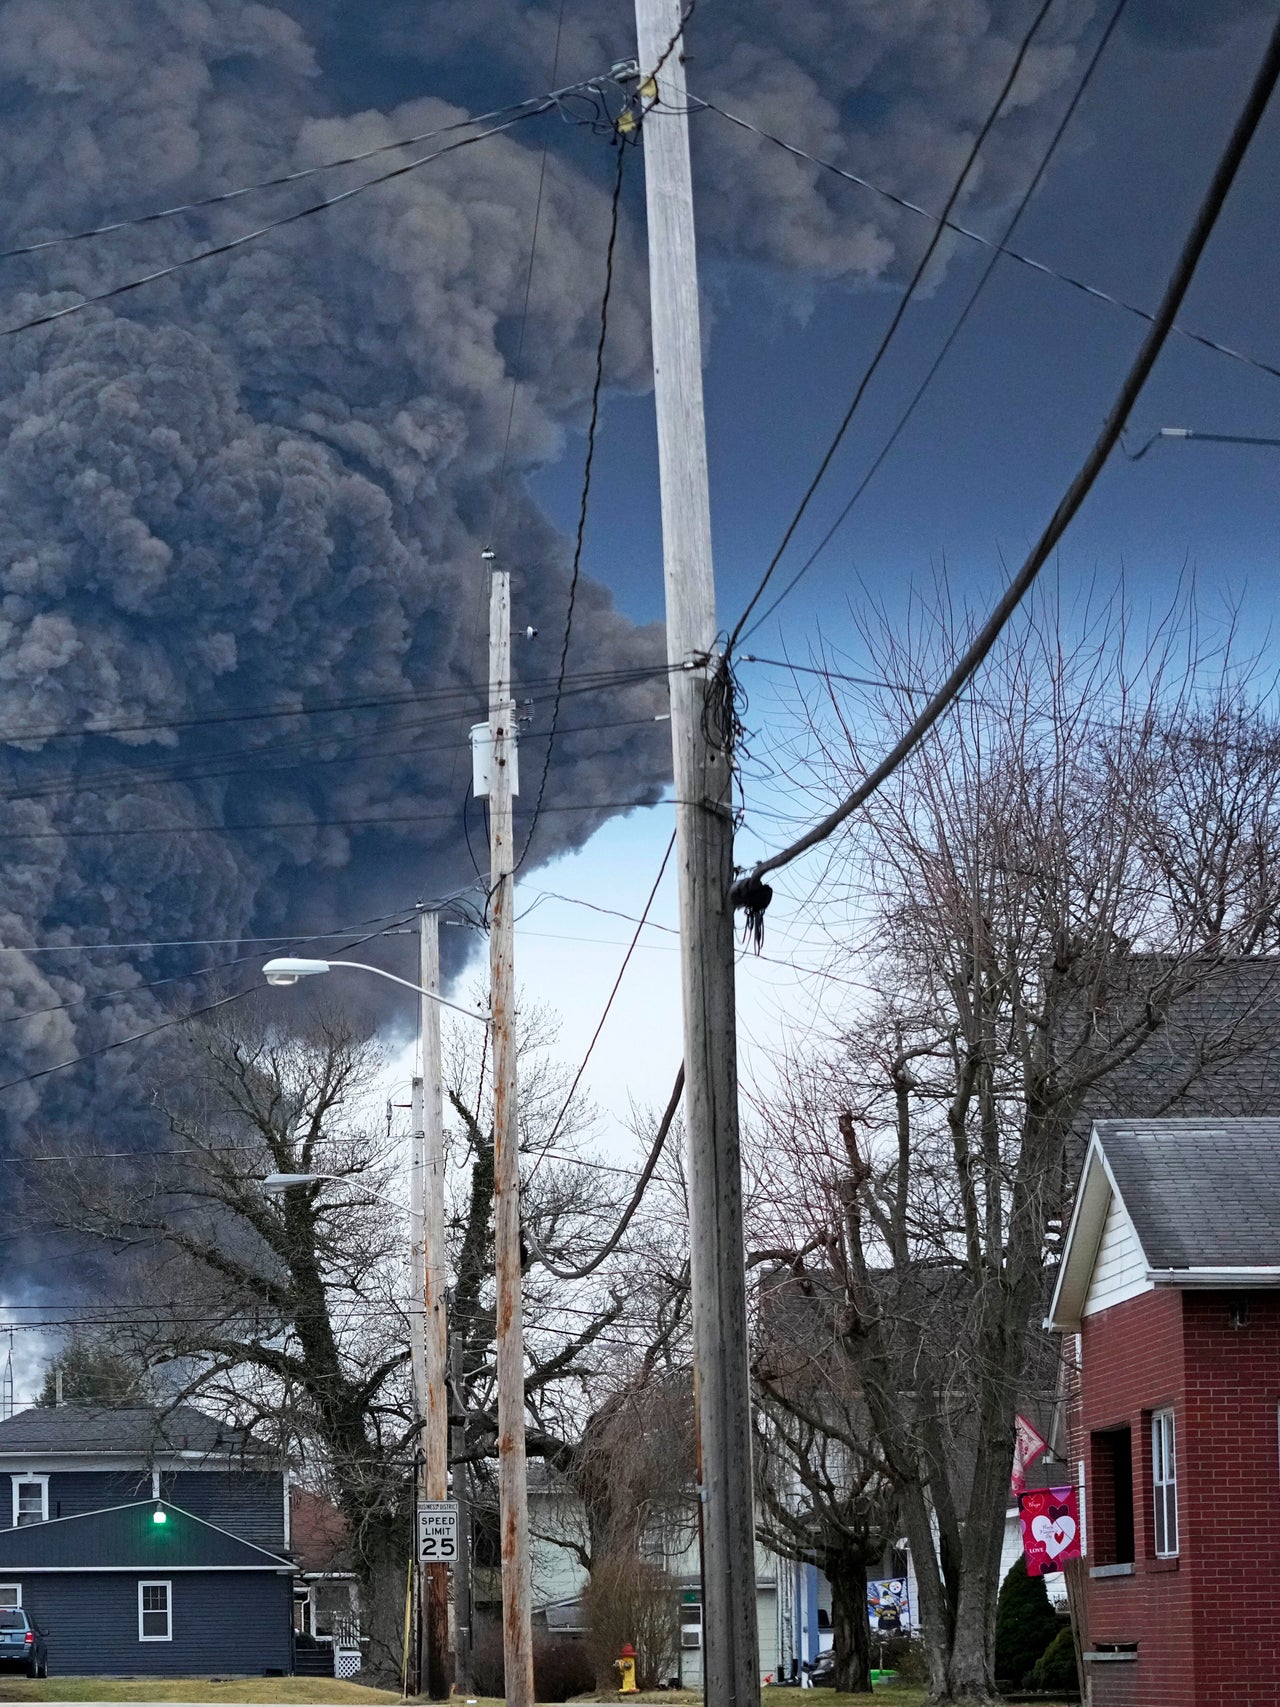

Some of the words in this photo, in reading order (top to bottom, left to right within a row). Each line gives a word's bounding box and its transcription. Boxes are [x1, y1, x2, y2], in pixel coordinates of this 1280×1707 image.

[421, 1517, 455, 1525] SPEED
[425, 1527, 451, 1535] LIMIT
[422, 1537, 455, 1556] 25
